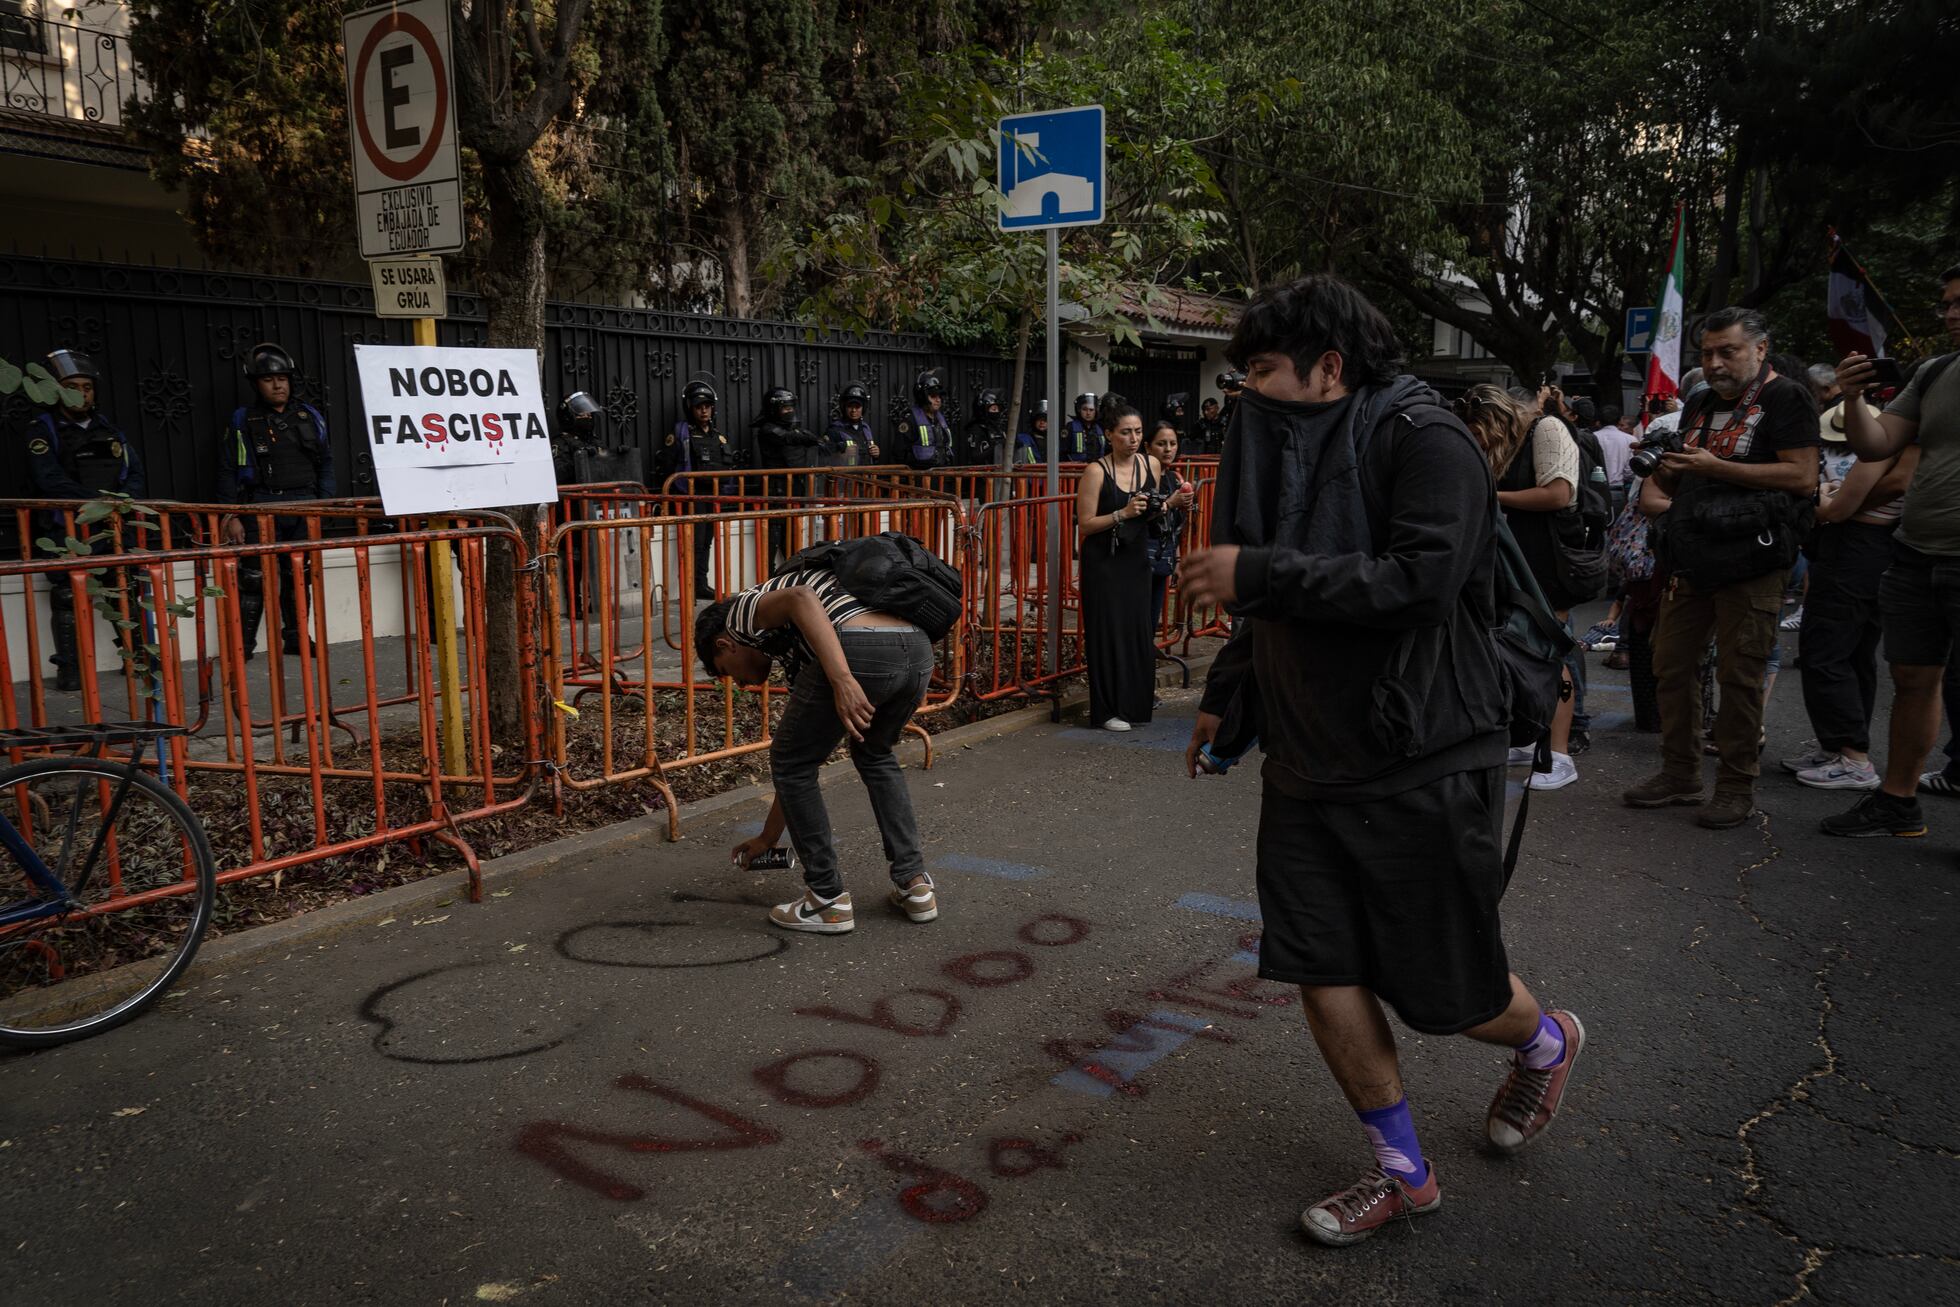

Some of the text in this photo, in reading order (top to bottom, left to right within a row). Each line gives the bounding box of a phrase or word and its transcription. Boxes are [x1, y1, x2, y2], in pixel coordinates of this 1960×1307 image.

[379, 44, 421, 150] E
[381, 186, 433, 211] EXCLUSIVO
[376, 206, 441, 233] EMBAJADA DE
[388, 228, 430, 251] ECUADOR
[381, 268, 396, 285] SE
[397, 286, 431, 309] GRÚA
[388, 366, 519, 397] NOBOA
[371, 412, 547, 445] FASCISTA
